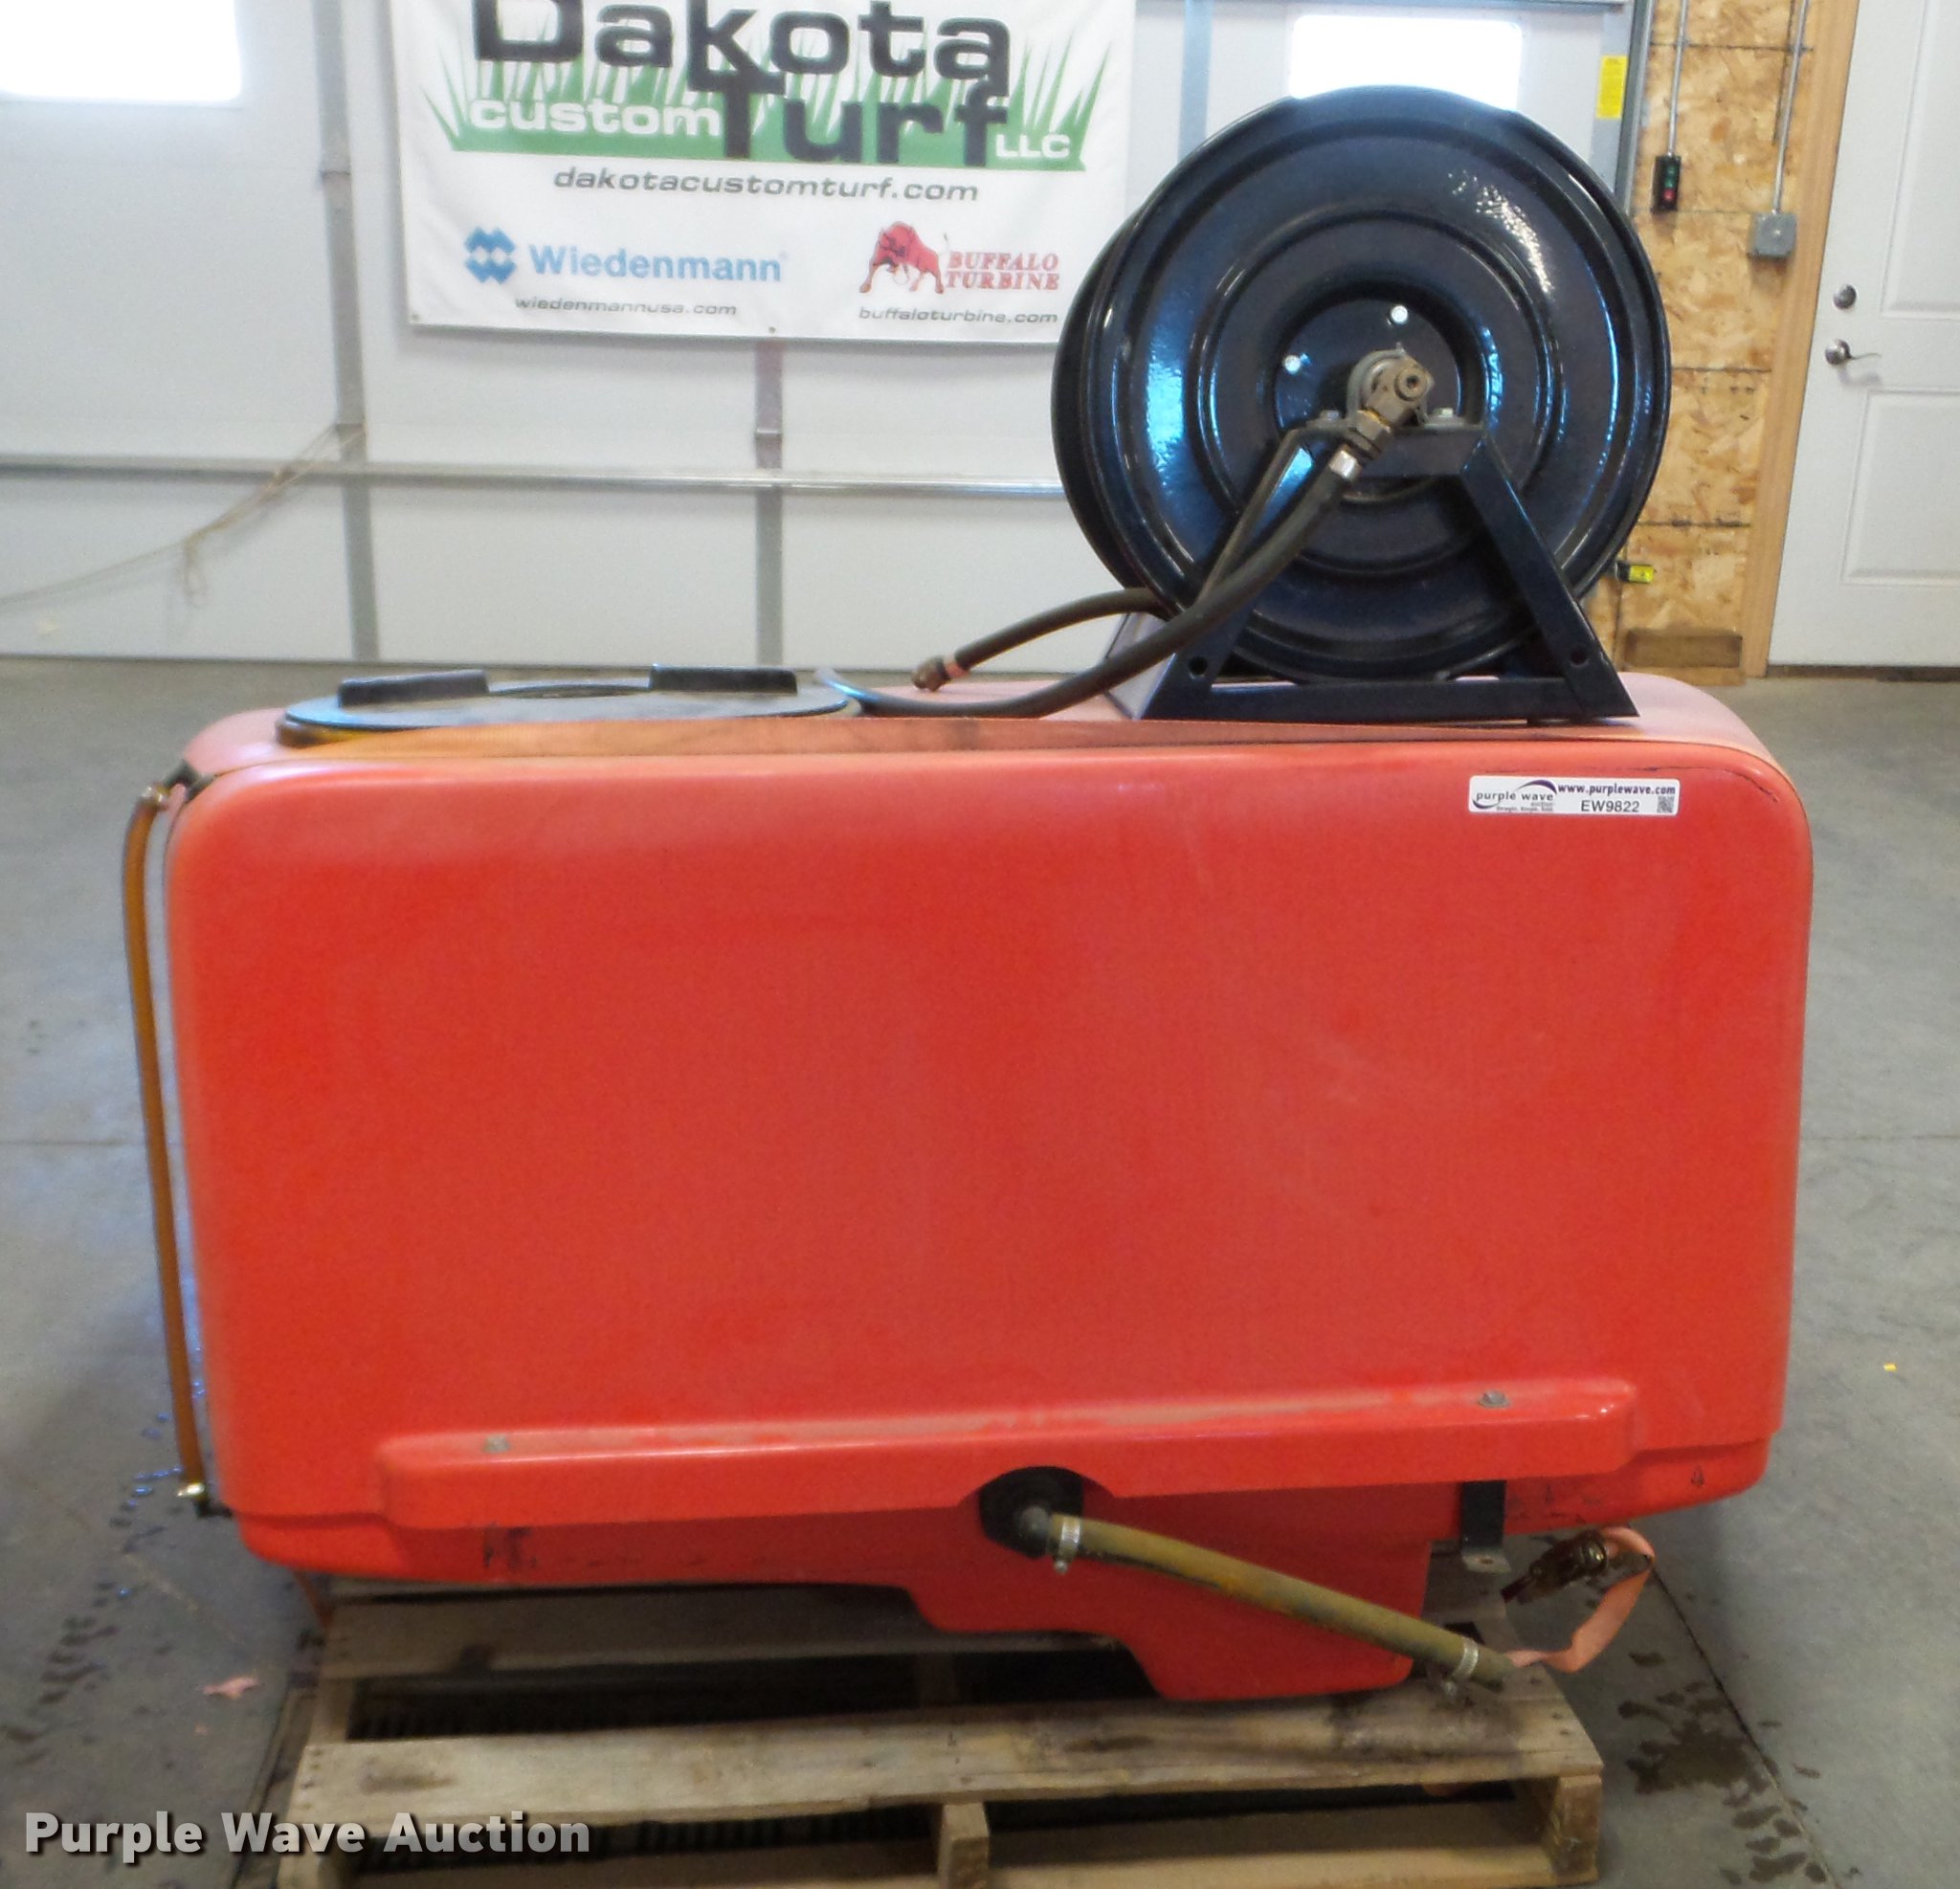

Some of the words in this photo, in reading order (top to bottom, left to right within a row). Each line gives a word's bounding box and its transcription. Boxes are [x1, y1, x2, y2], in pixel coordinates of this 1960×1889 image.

[472, 0, 1011, 82] Dakota
[470, 98, 721, 137] custom
[687, 72, 1009, 167] Turf
[995, 134, 1071, 159] LLC
[553, 167, 979, 201] dakotacustomturf.com
[529, 244, 782, 282] Wiedenmann
[948, 251, 1059, 271] BUFFALO
[945, 271, 1060, 291] TURBINE
[515, 296, 738, 316] wiedenmannusa.com
[858, 306, 1058, 323] buffaloturbine.com
[1476, 791, 1517, 803] purple
[1558, 784, 1676, 796] www.purplewave.com
[1580, 800, 1640, 812] EW9822
